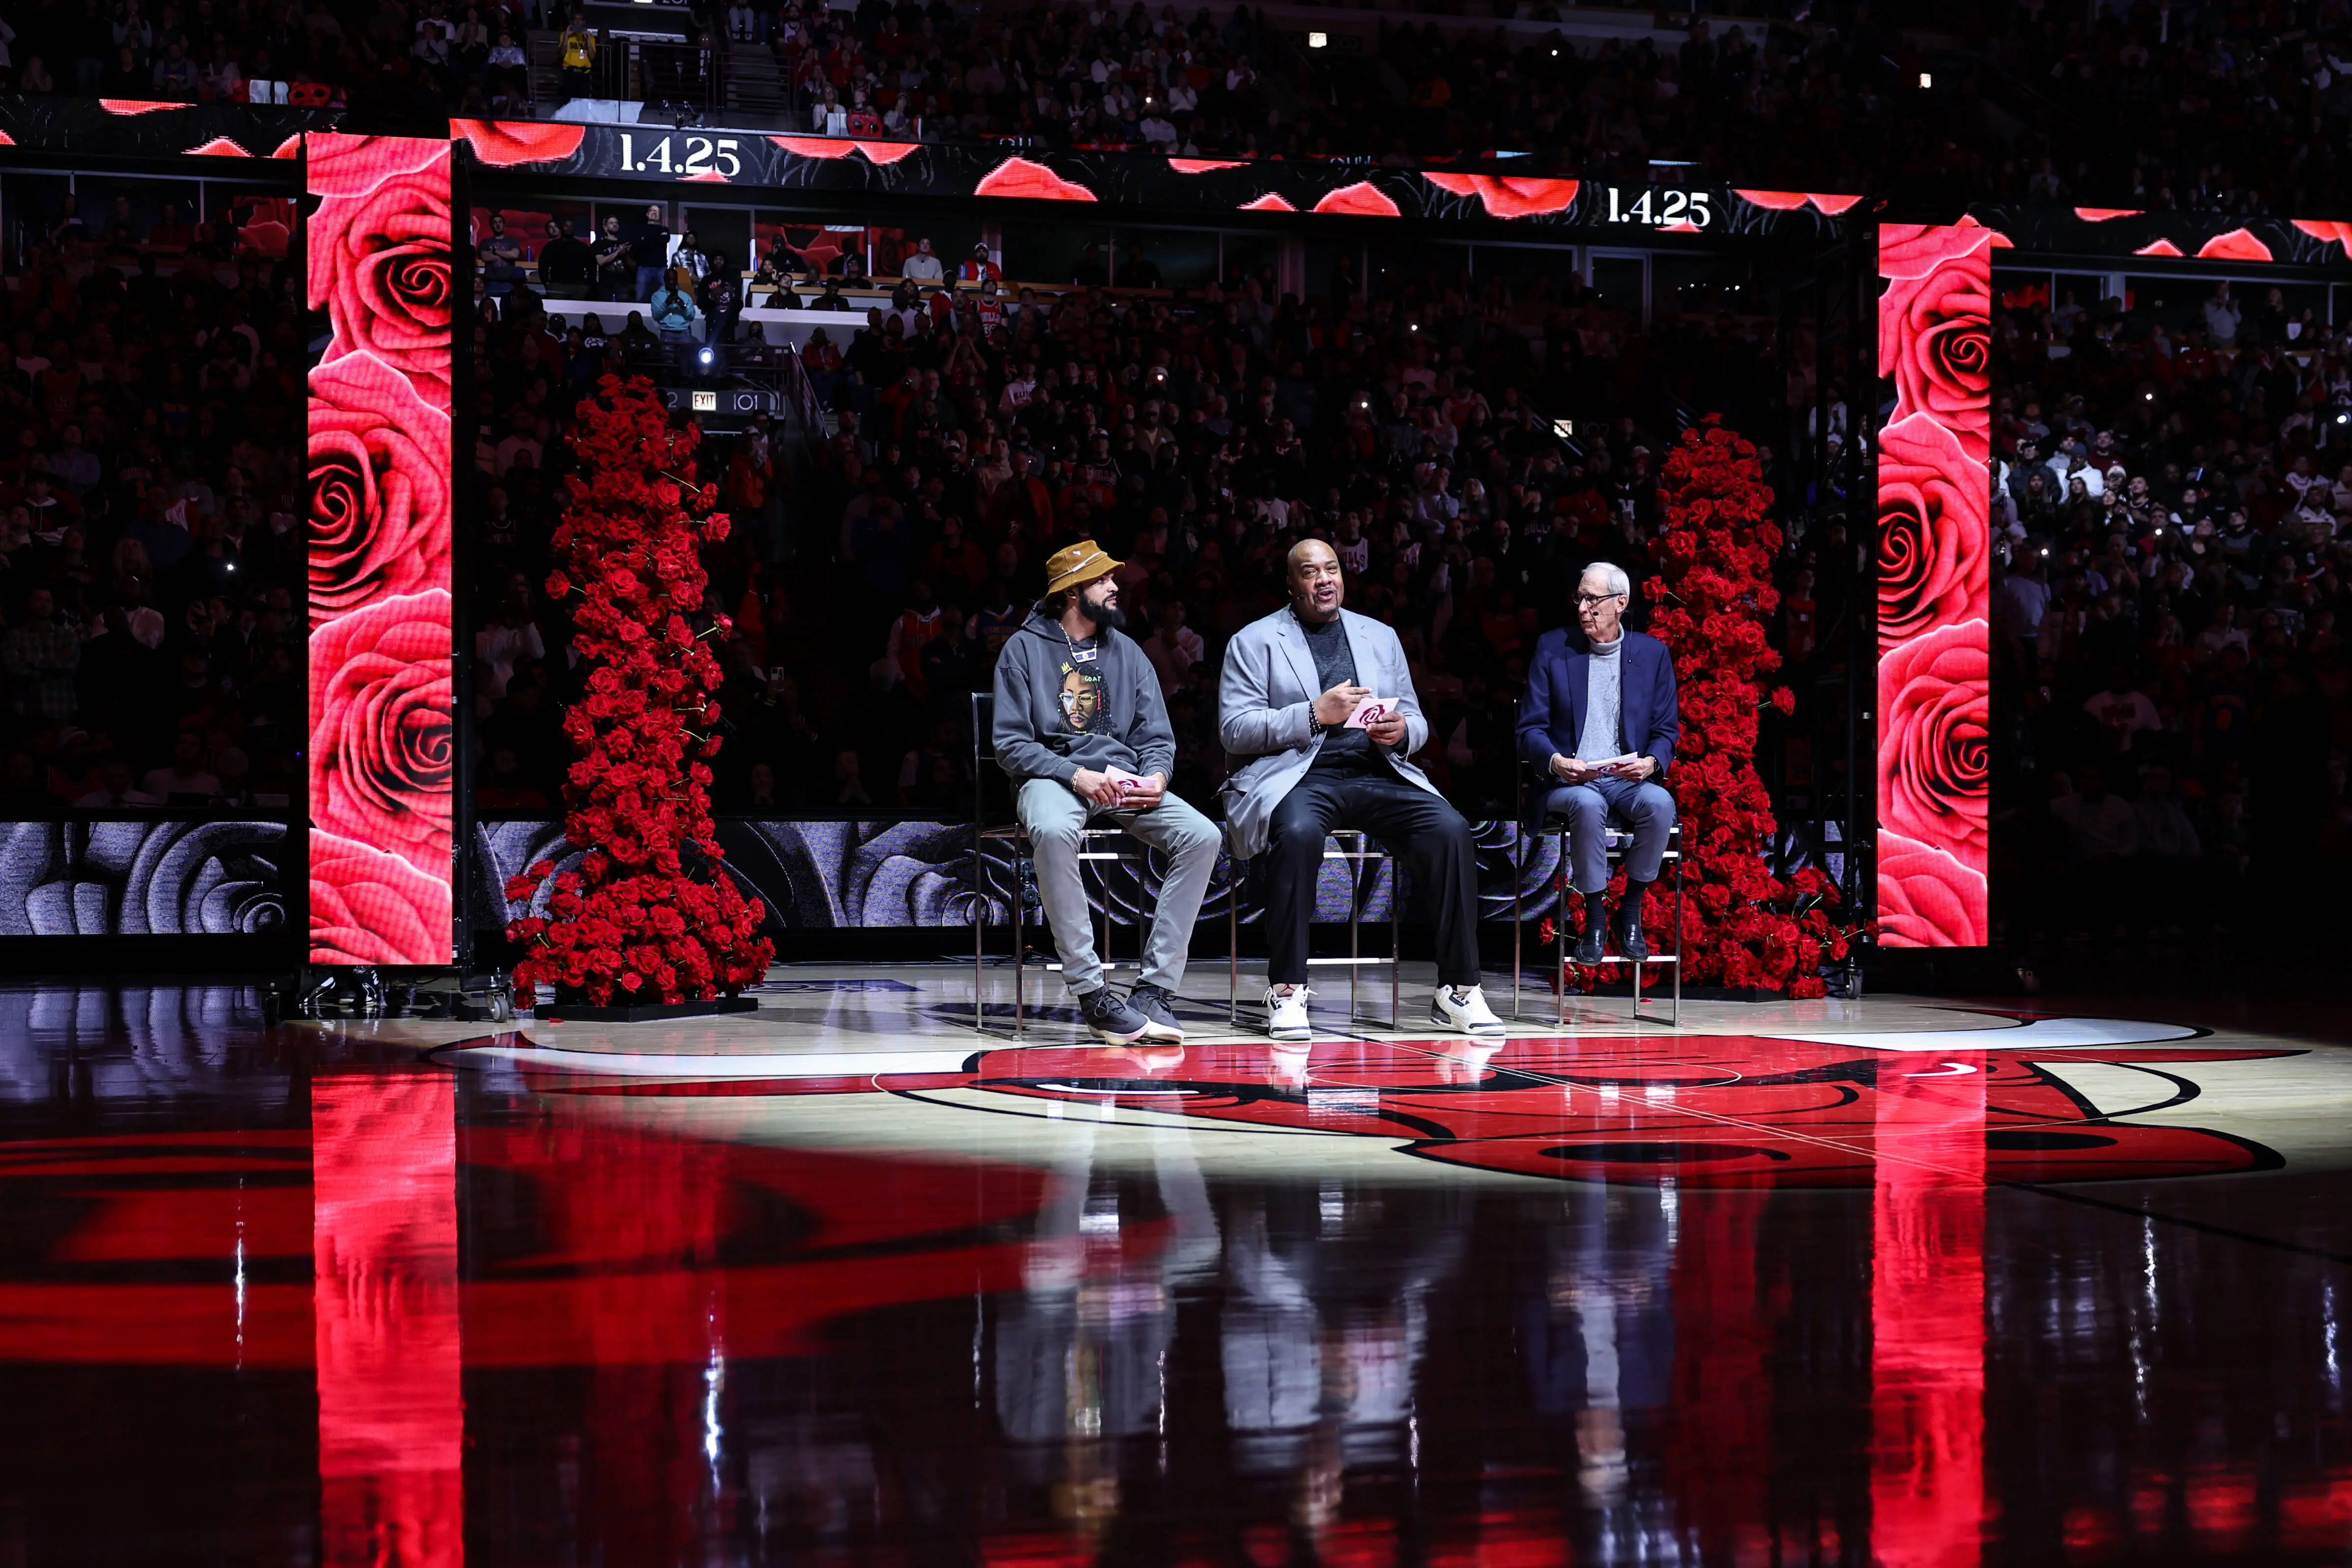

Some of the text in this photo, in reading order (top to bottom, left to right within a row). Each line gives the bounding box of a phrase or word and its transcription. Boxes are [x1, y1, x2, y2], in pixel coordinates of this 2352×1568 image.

[620, 134, 740, 177] 1.4.25
[1608, 188, 1711, 227] 1.4.25
[694, 394, 714, 407] EXIT
[733, 394, 758, 410] 101
